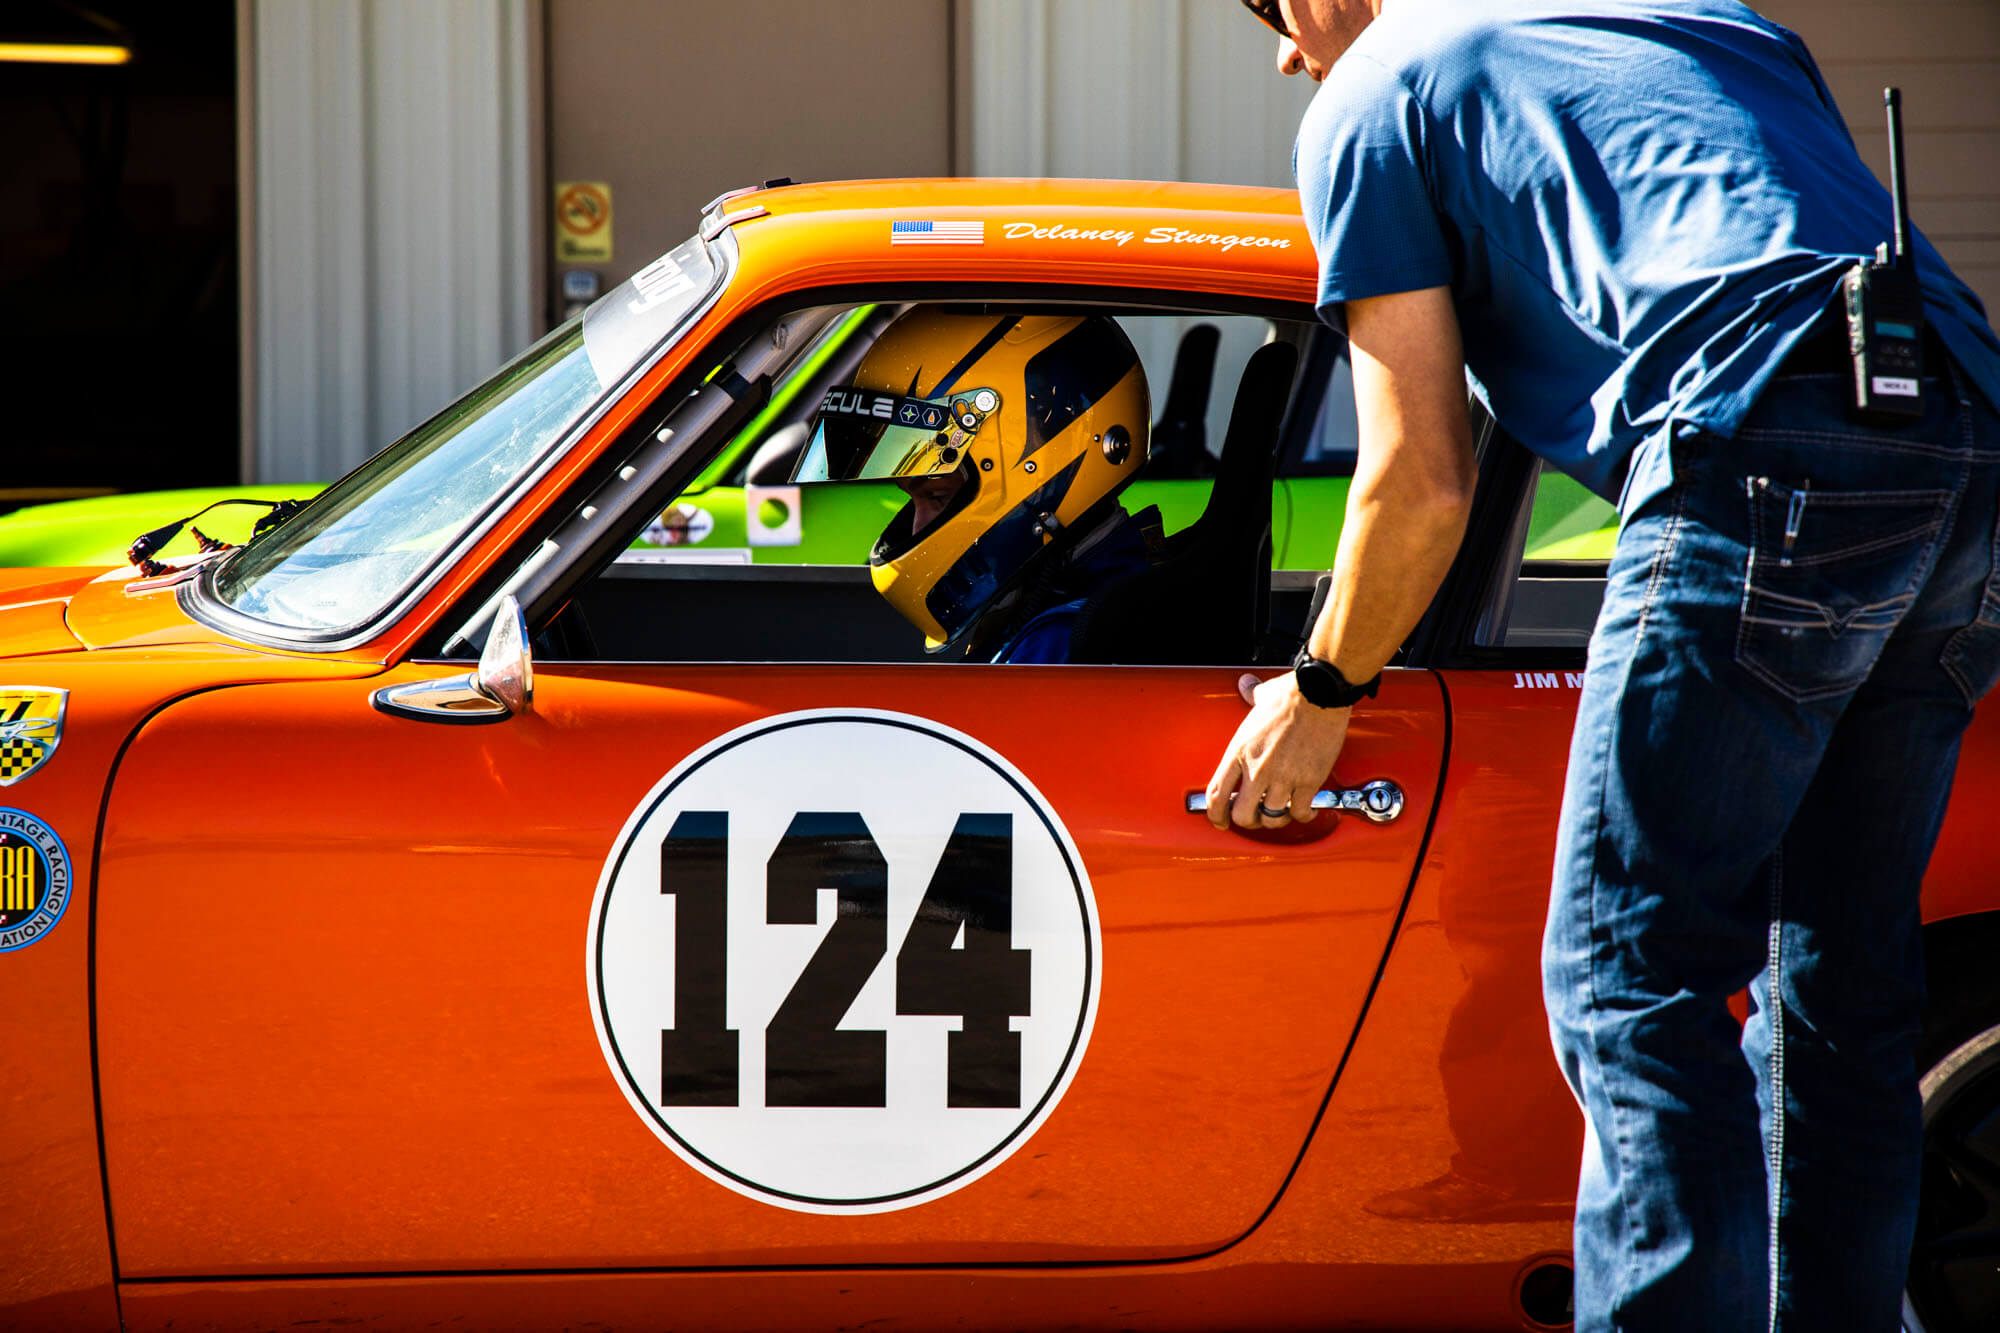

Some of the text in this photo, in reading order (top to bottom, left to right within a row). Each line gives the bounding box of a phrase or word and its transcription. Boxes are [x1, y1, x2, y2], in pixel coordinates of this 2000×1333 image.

[1002, 222, 1292, 252] Delaney Sturgeon
[1513, 672, 1560, 689] JIM
[46, 844, 66, 912] RACING
[1, 915, 49, 946] ATION
[660, 810, 1032, 1109] 124
